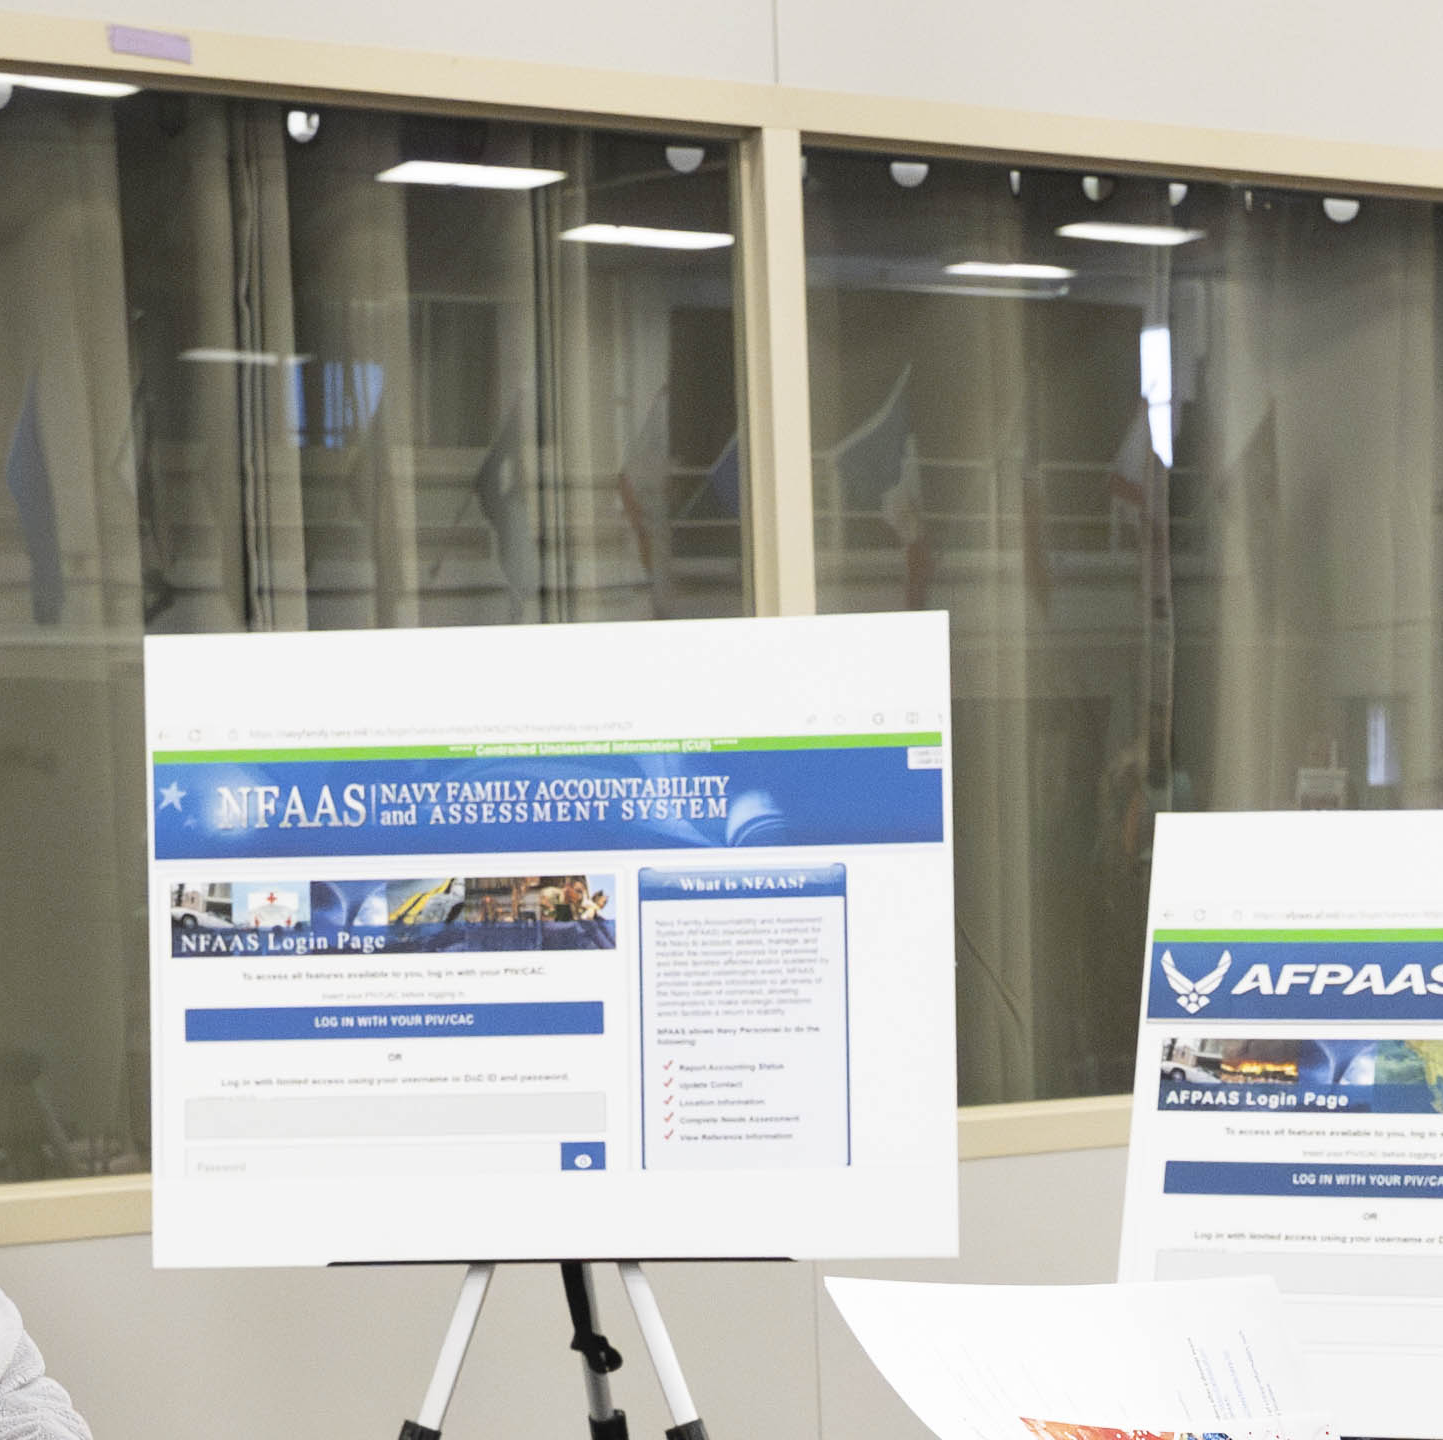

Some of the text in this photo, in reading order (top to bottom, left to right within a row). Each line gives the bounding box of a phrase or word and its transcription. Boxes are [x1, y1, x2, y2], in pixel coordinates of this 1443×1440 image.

[380, 776, 730, 803] NAVY FAMILY ACCOUNTABILITY
[216, 783, 367, 829] NFAAS
[380, 797, 729, 826] and ASSESSMENT SYSTEM
[679, 874, 807, 892] What is NFAAS?
[180, 930, 386, 955] NFAAS Login Page
[314, 1013, 475, 1029] LOG IN WITH YOUR PIV/CAC
[1166, 1090, 1349, 1109] AFPAAS Login Page
[1292, 1173, 1317, 1186] LOG
[1318, 1174, 1333, 1186] IN
[1335, 1174, 1367, 1187] WITH
[1369, 1174, 1402, 1188] YOUR
